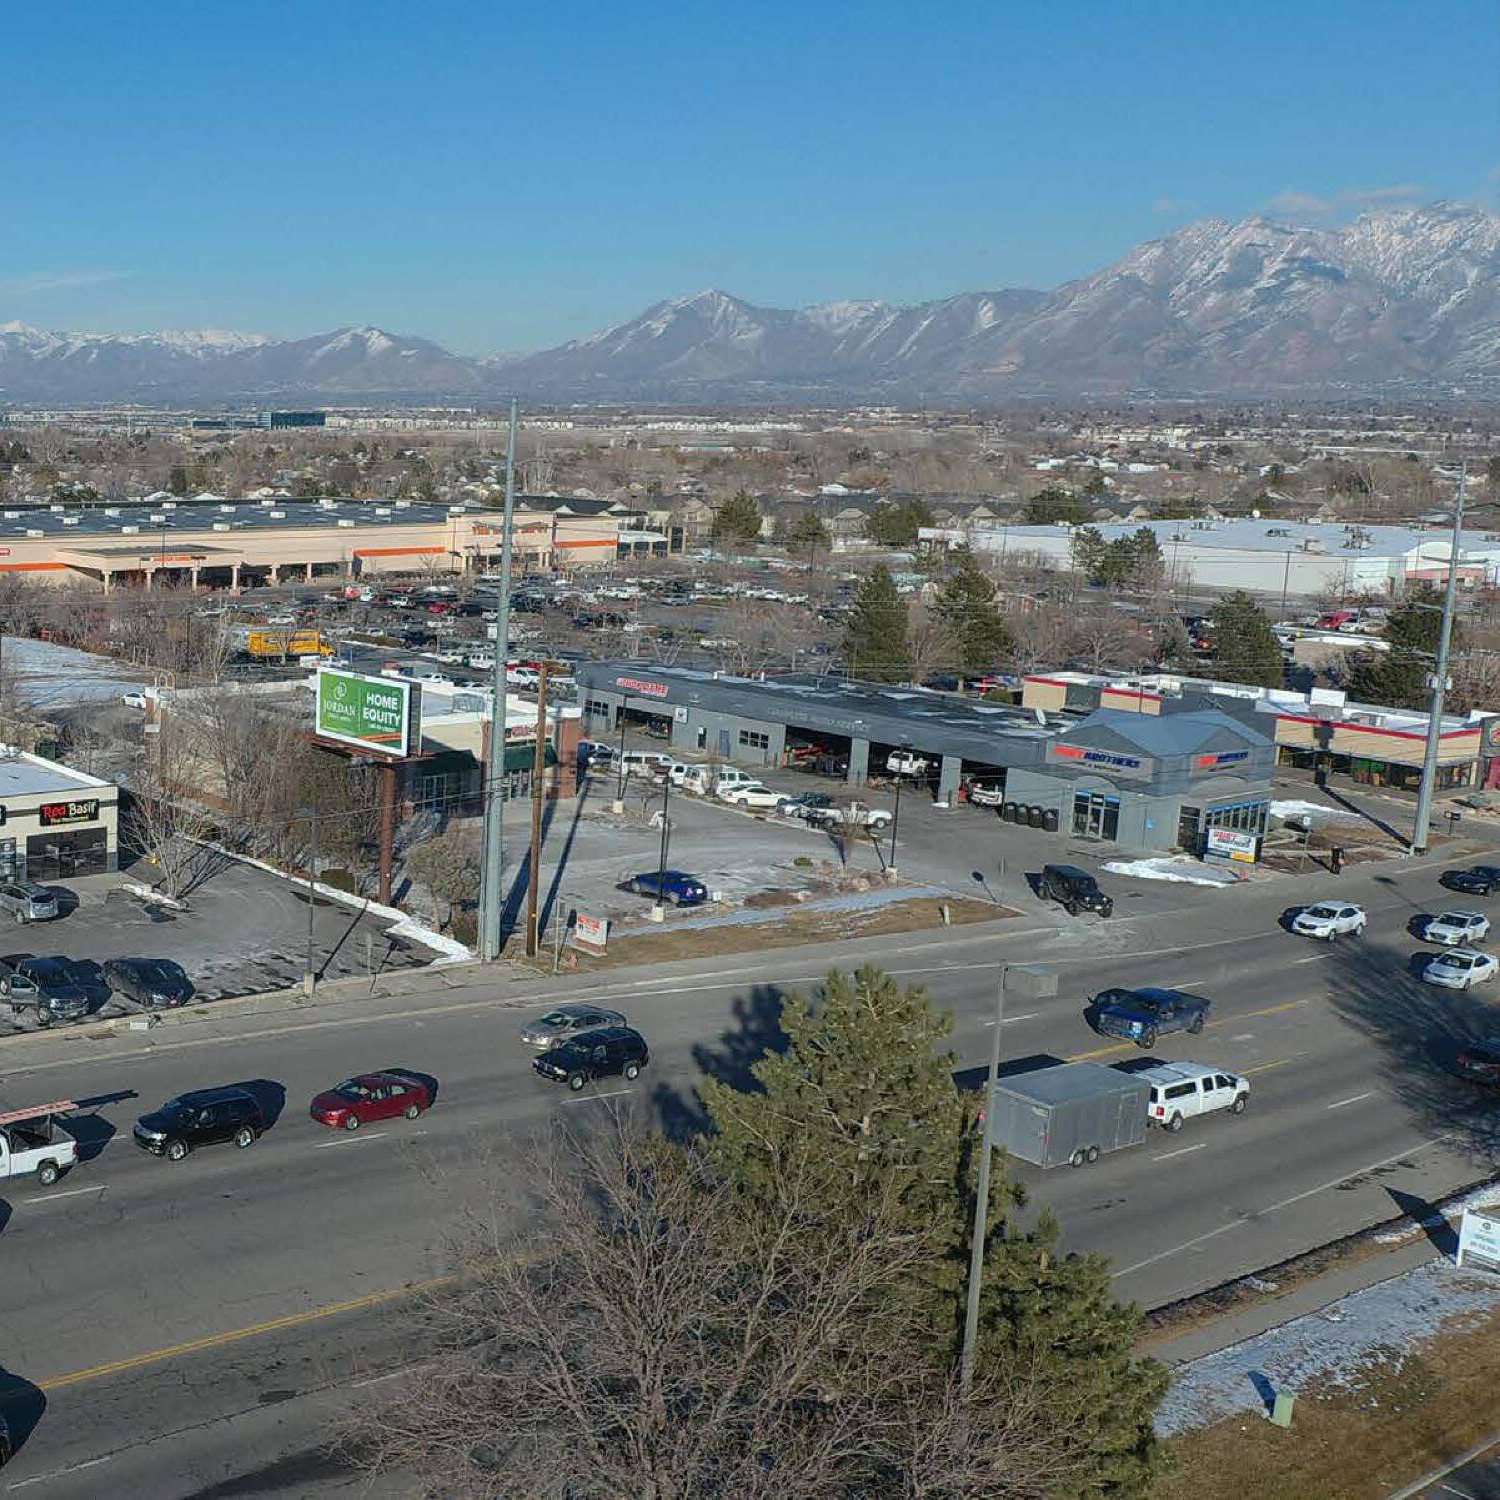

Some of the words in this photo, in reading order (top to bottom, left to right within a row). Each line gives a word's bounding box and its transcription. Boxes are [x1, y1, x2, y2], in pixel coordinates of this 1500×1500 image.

[323, 699, 356, 717] JORDAN
[366, 691, 398, 711] HOME
[362, 706, 401, 728] EQUITY
[42, 805, 66, 819] Red
